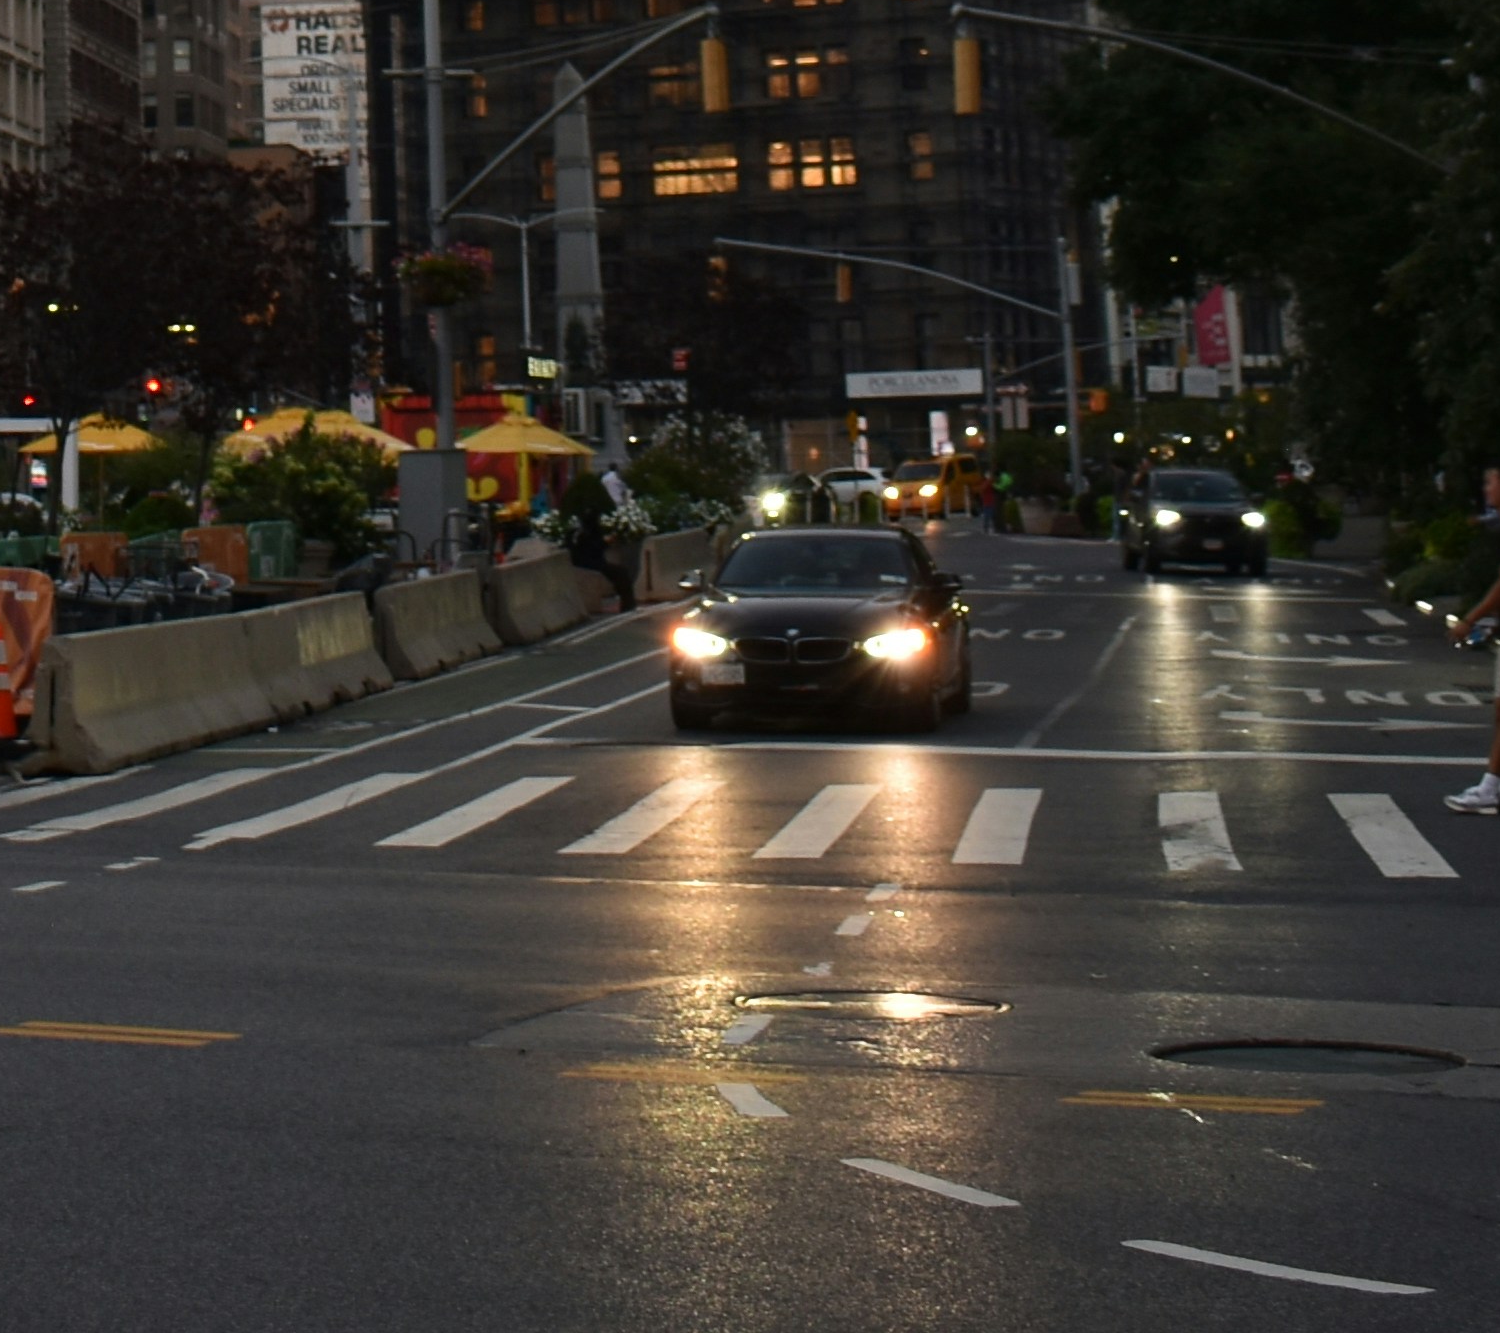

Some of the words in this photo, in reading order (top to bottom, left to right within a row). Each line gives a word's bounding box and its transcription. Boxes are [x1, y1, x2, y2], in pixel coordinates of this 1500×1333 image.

[297, 34, 367, 55] REAL
[289, 80, 332, 94] SMALL
[273, 96, 354, 112] SPECIALIST
[1198, 684, 1486, 707] ONLY
